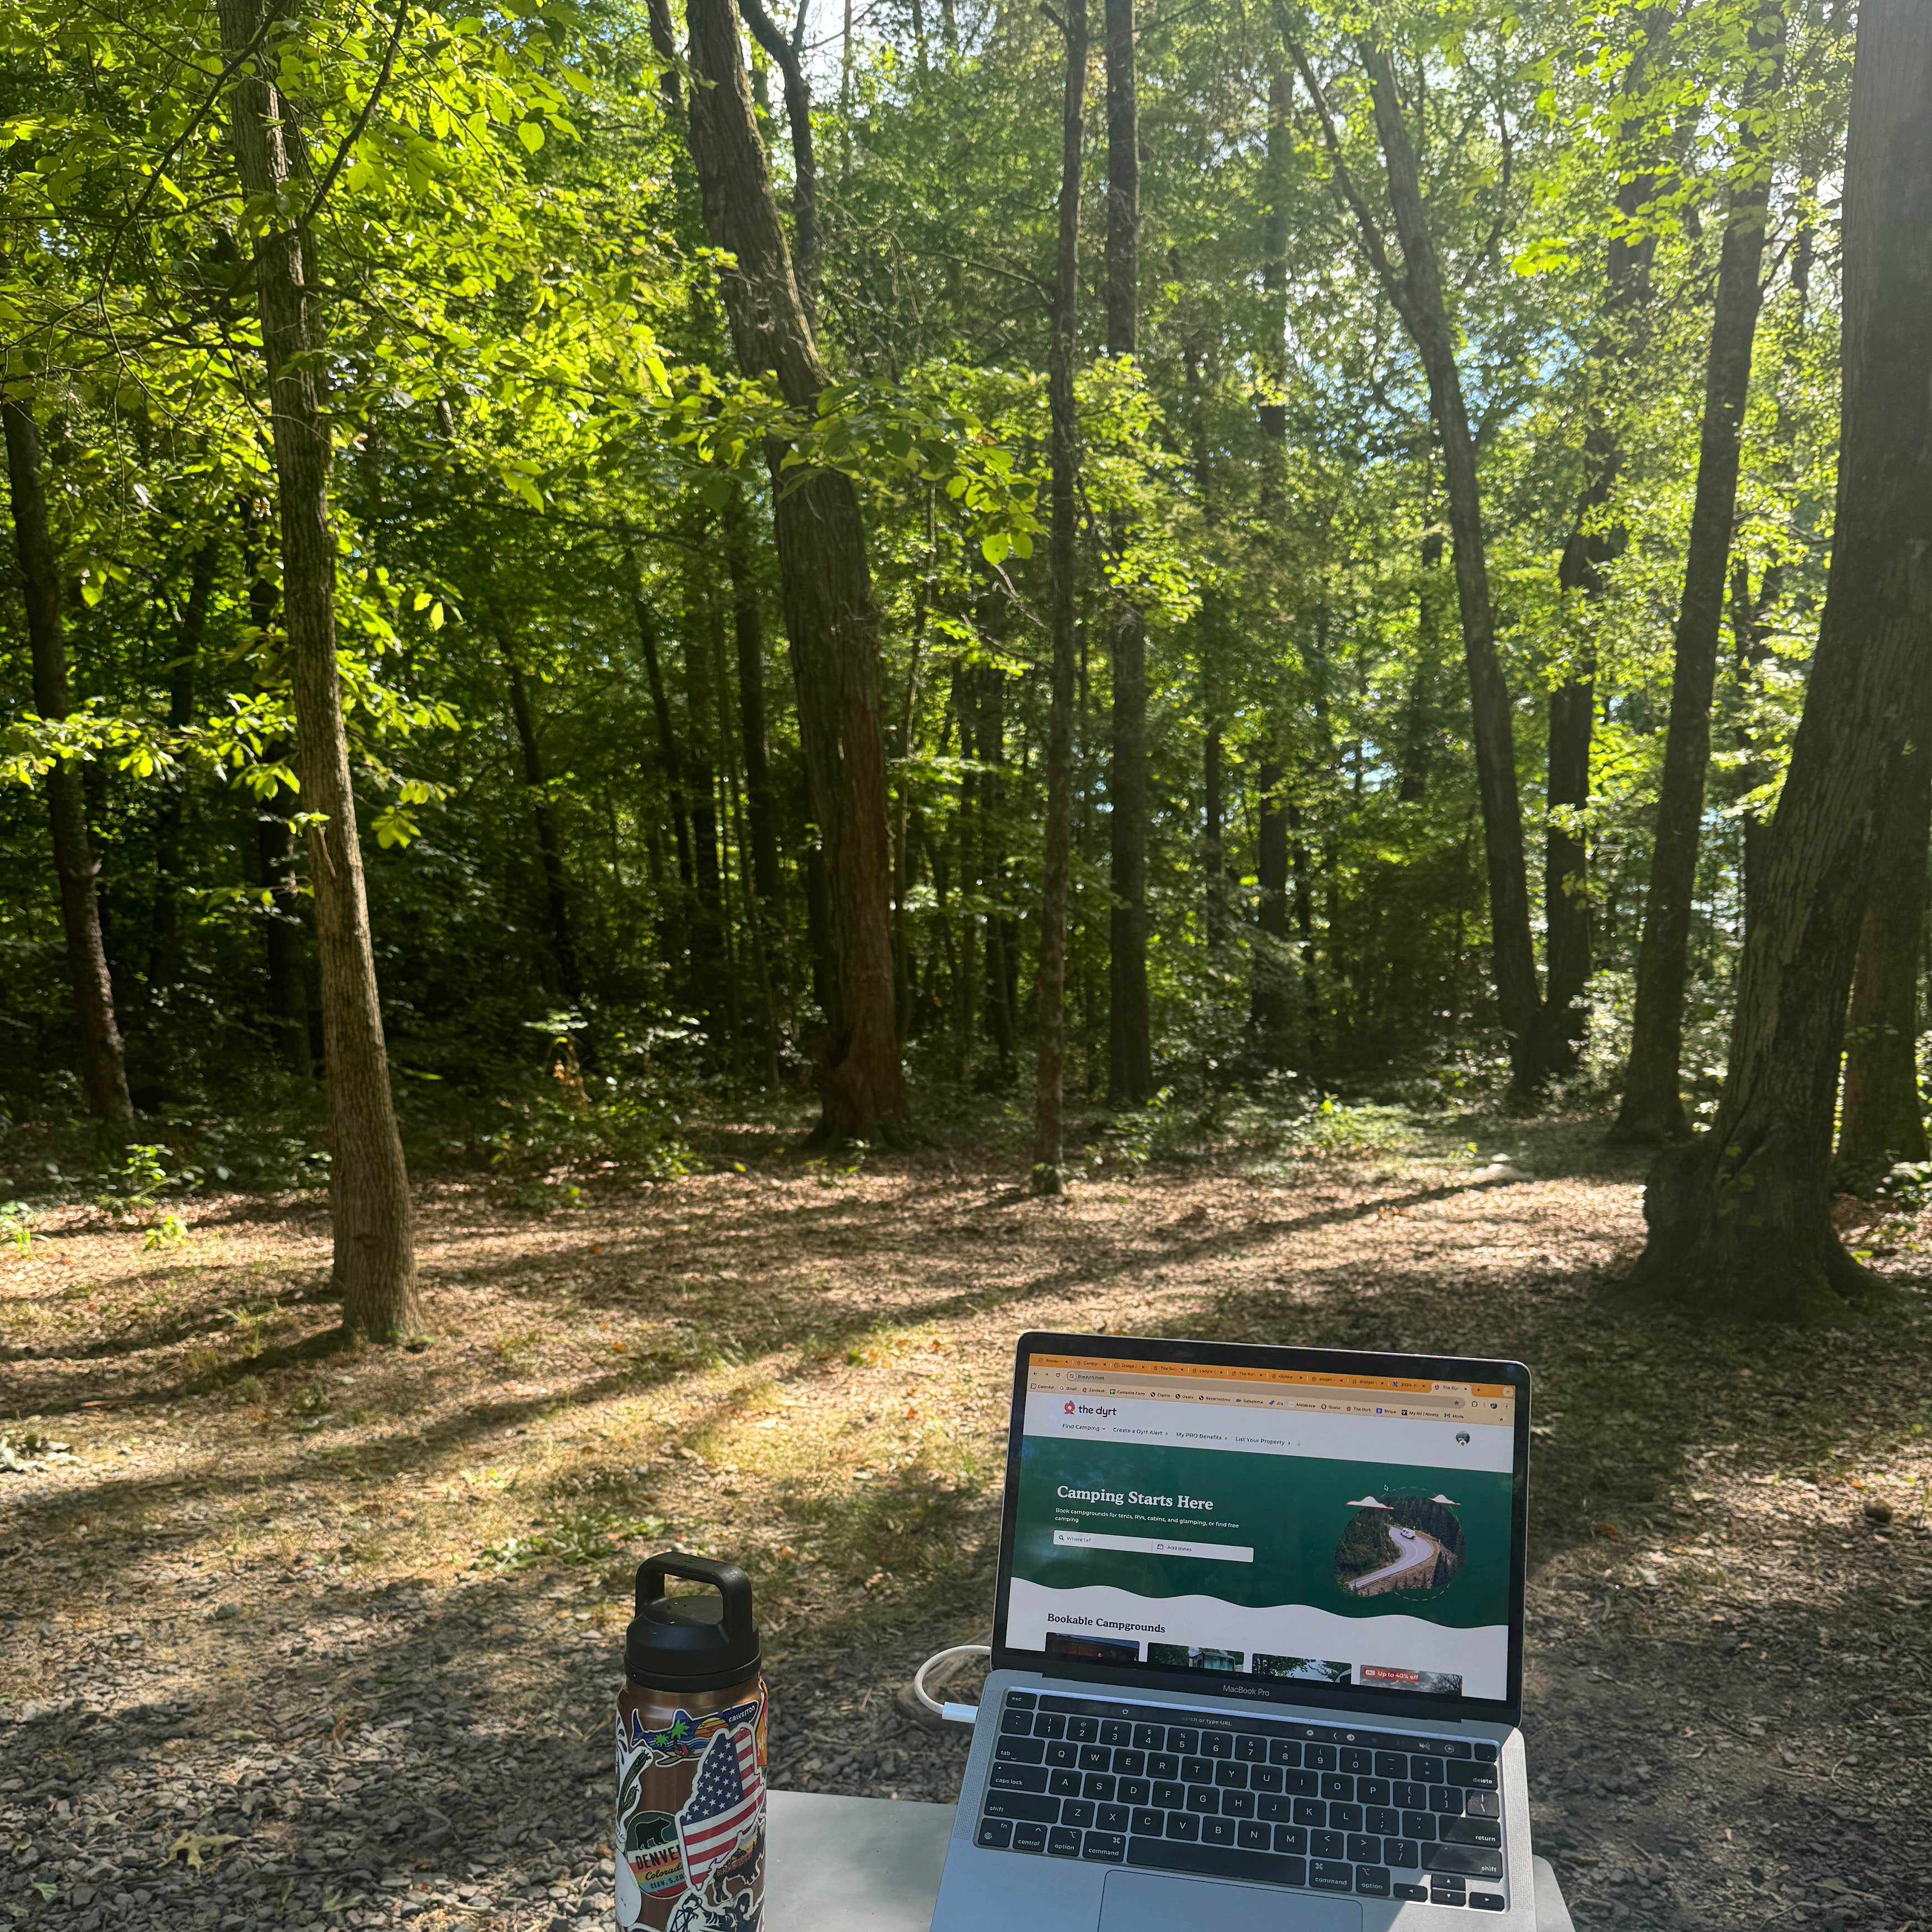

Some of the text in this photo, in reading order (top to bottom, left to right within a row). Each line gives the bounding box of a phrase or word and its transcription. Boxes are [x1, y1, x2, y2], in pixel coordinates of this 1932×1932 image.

[1078, 1405, 1117, 1417] the dyrt
[1057, 1485, 1214, 1510] Camping Starts Here
[1179, 1518, 1208, 1527] glamping,
[1047, 1613, 1165, 1633] Bookable Campgrounds
[1222, 1684, 1270, 1697] MacBook Pro
[1109, 1813, 1116, 1821] X
[1286, 1835, 1294, 1843] M
[645, 1862, 684, 1881] Colorad
[1315, 1877, 1347, 1885] command
